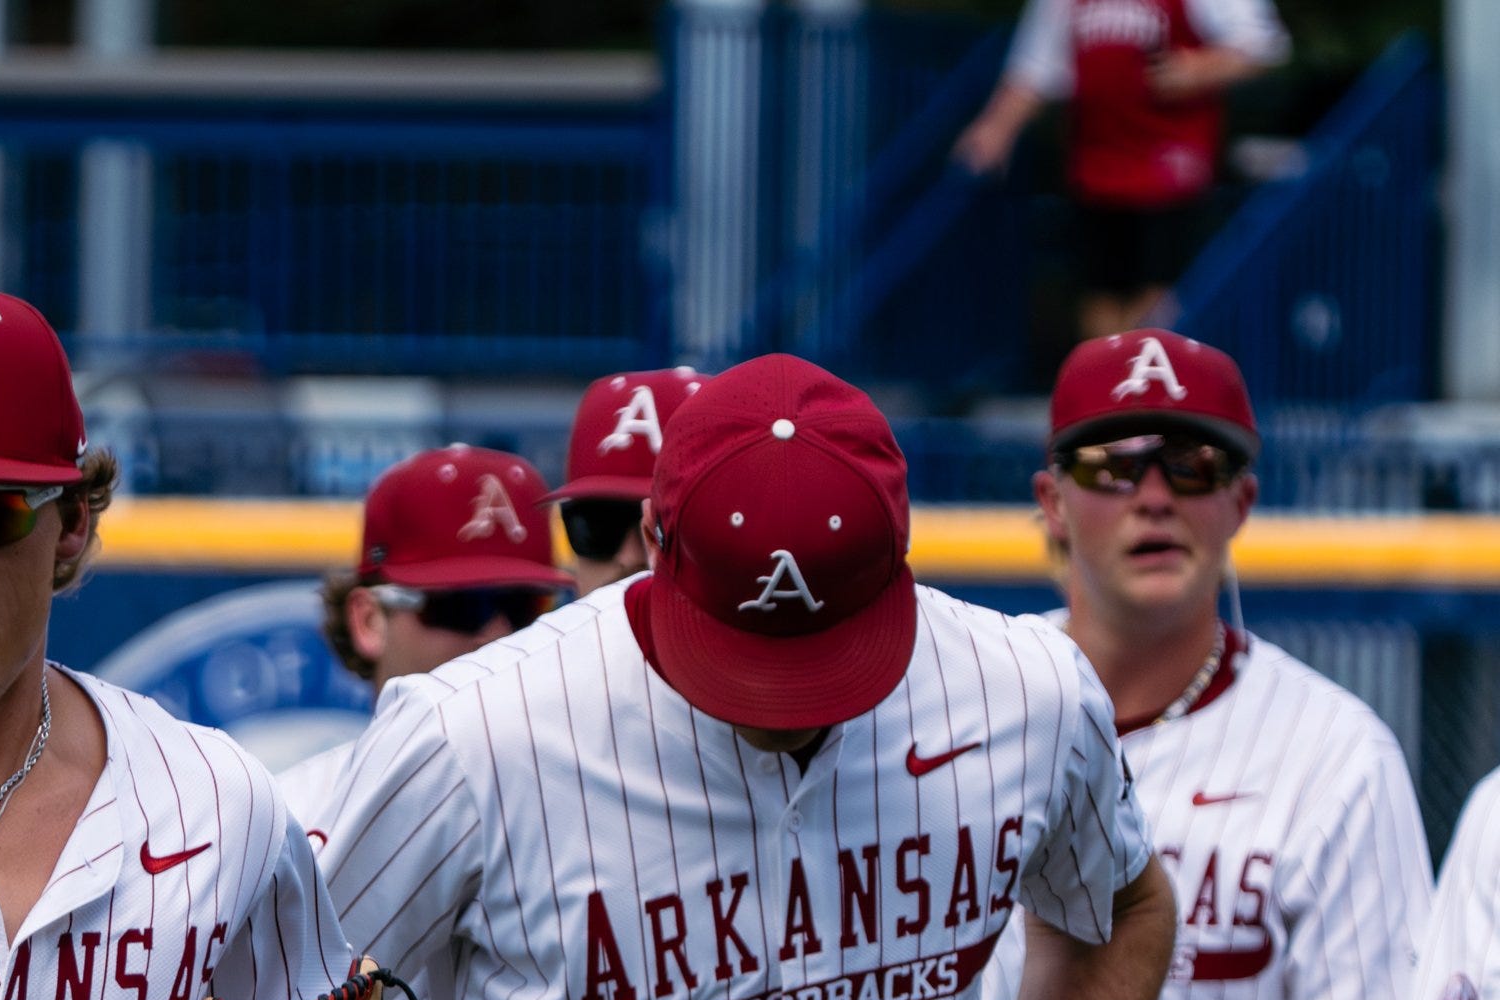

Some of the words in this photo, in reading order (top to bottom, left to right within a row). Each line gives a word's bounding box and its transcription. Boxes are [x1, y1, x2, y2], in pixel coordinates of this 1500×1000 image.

[1109, 336, 1188, 401] A
[599, 384, 663, 455] A
[456, 473, 528, 543] A
[737, 549, 825, 612] A
